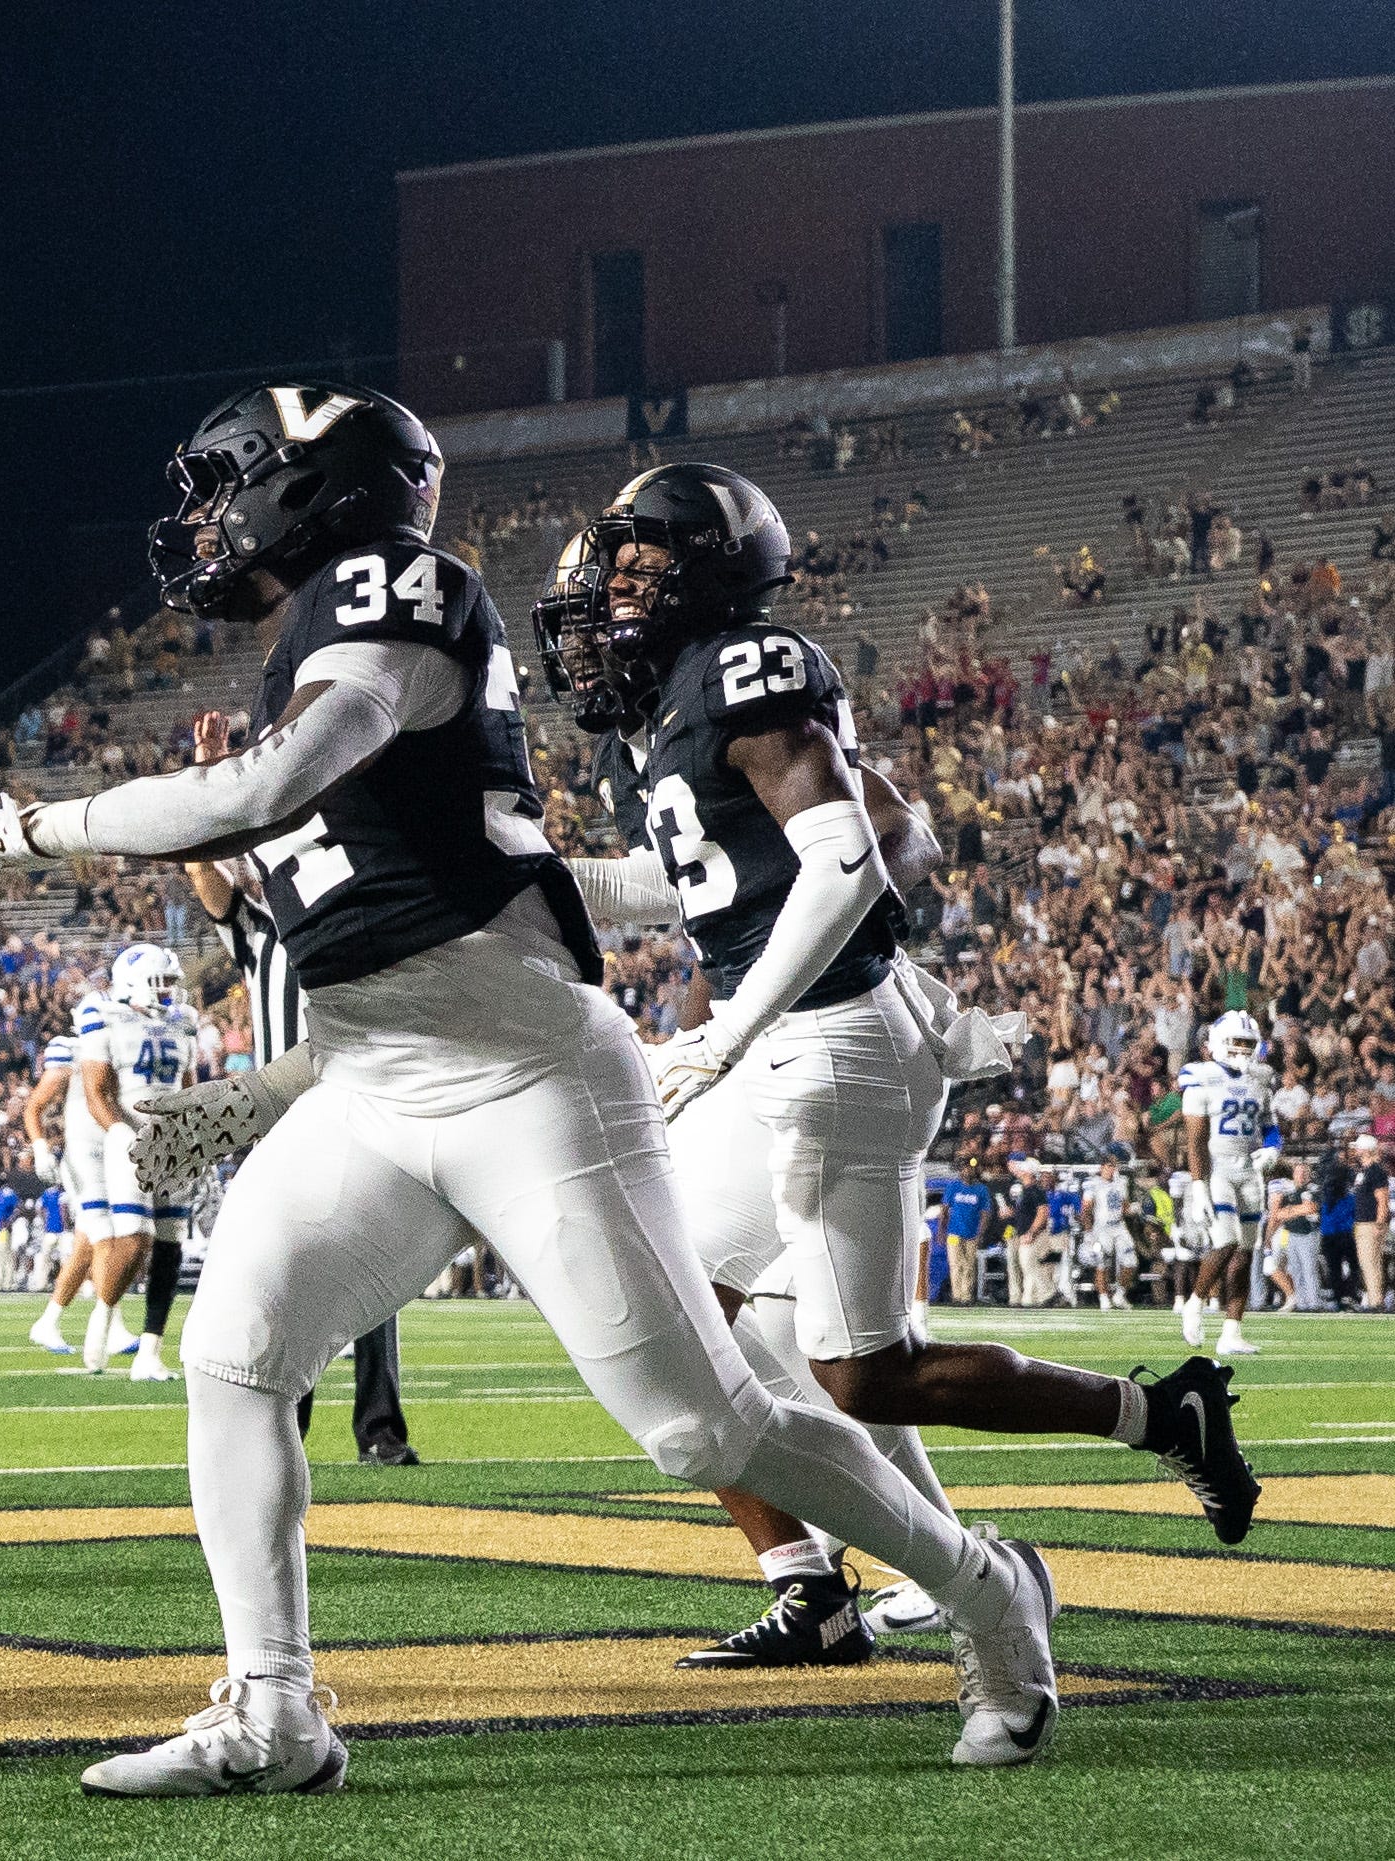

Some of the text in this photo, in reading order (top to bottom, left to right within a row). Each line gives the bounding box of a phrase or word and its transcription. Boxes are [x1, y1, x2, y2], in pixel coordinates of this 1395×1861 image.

[267, 387, 364, 442] V
[336, 554, 444, 626] 34
[719, 636, 806, 706] 23
[133, 1038, 179, 1085] 45
[818, 1599, 858, 1650] NIKE
